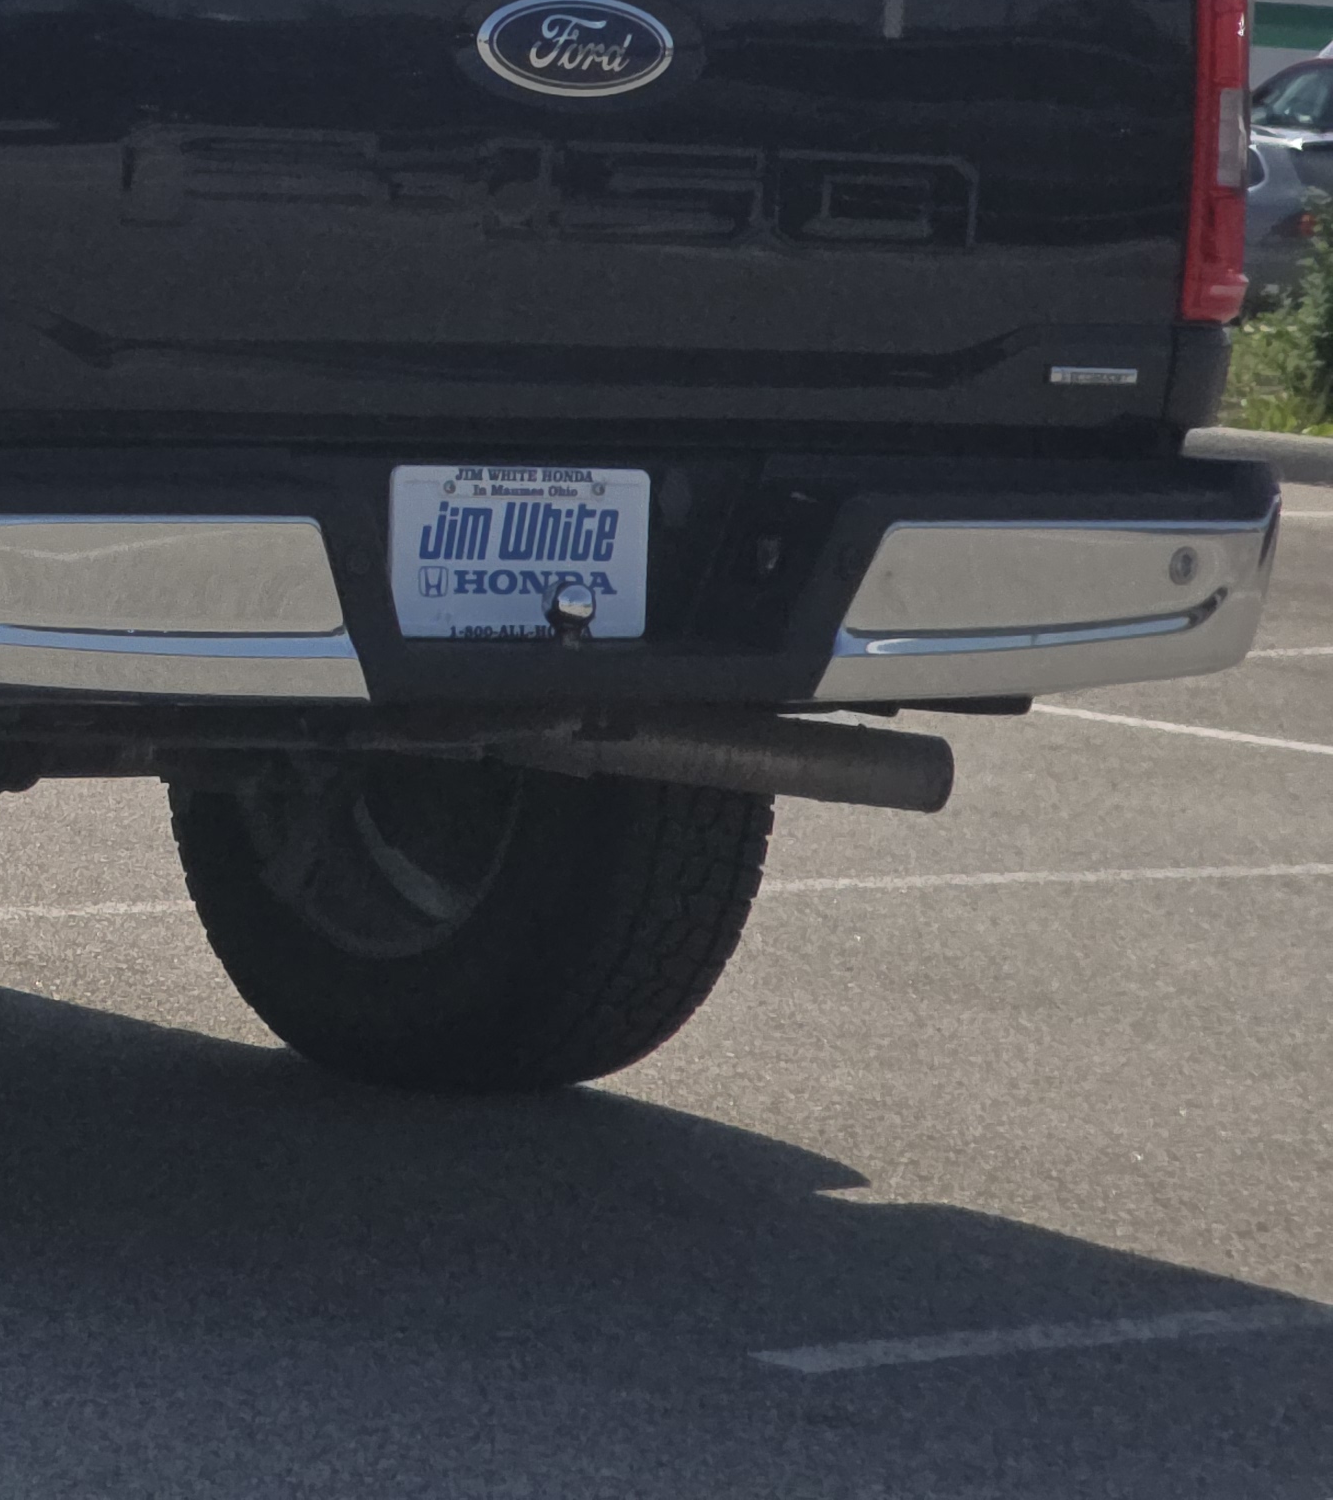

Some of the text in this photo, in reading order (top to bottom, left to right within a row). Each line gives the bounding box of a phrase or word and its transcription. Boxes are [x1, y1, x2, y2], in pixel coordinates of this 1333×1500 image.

[528, 13, 633, 73] Ford
[455, 468, 594, 483] JIM WHITE HONDA
[473, 484, 579, 497] In Maumee Ohio
[419, 501, 619, 561] Jim White
